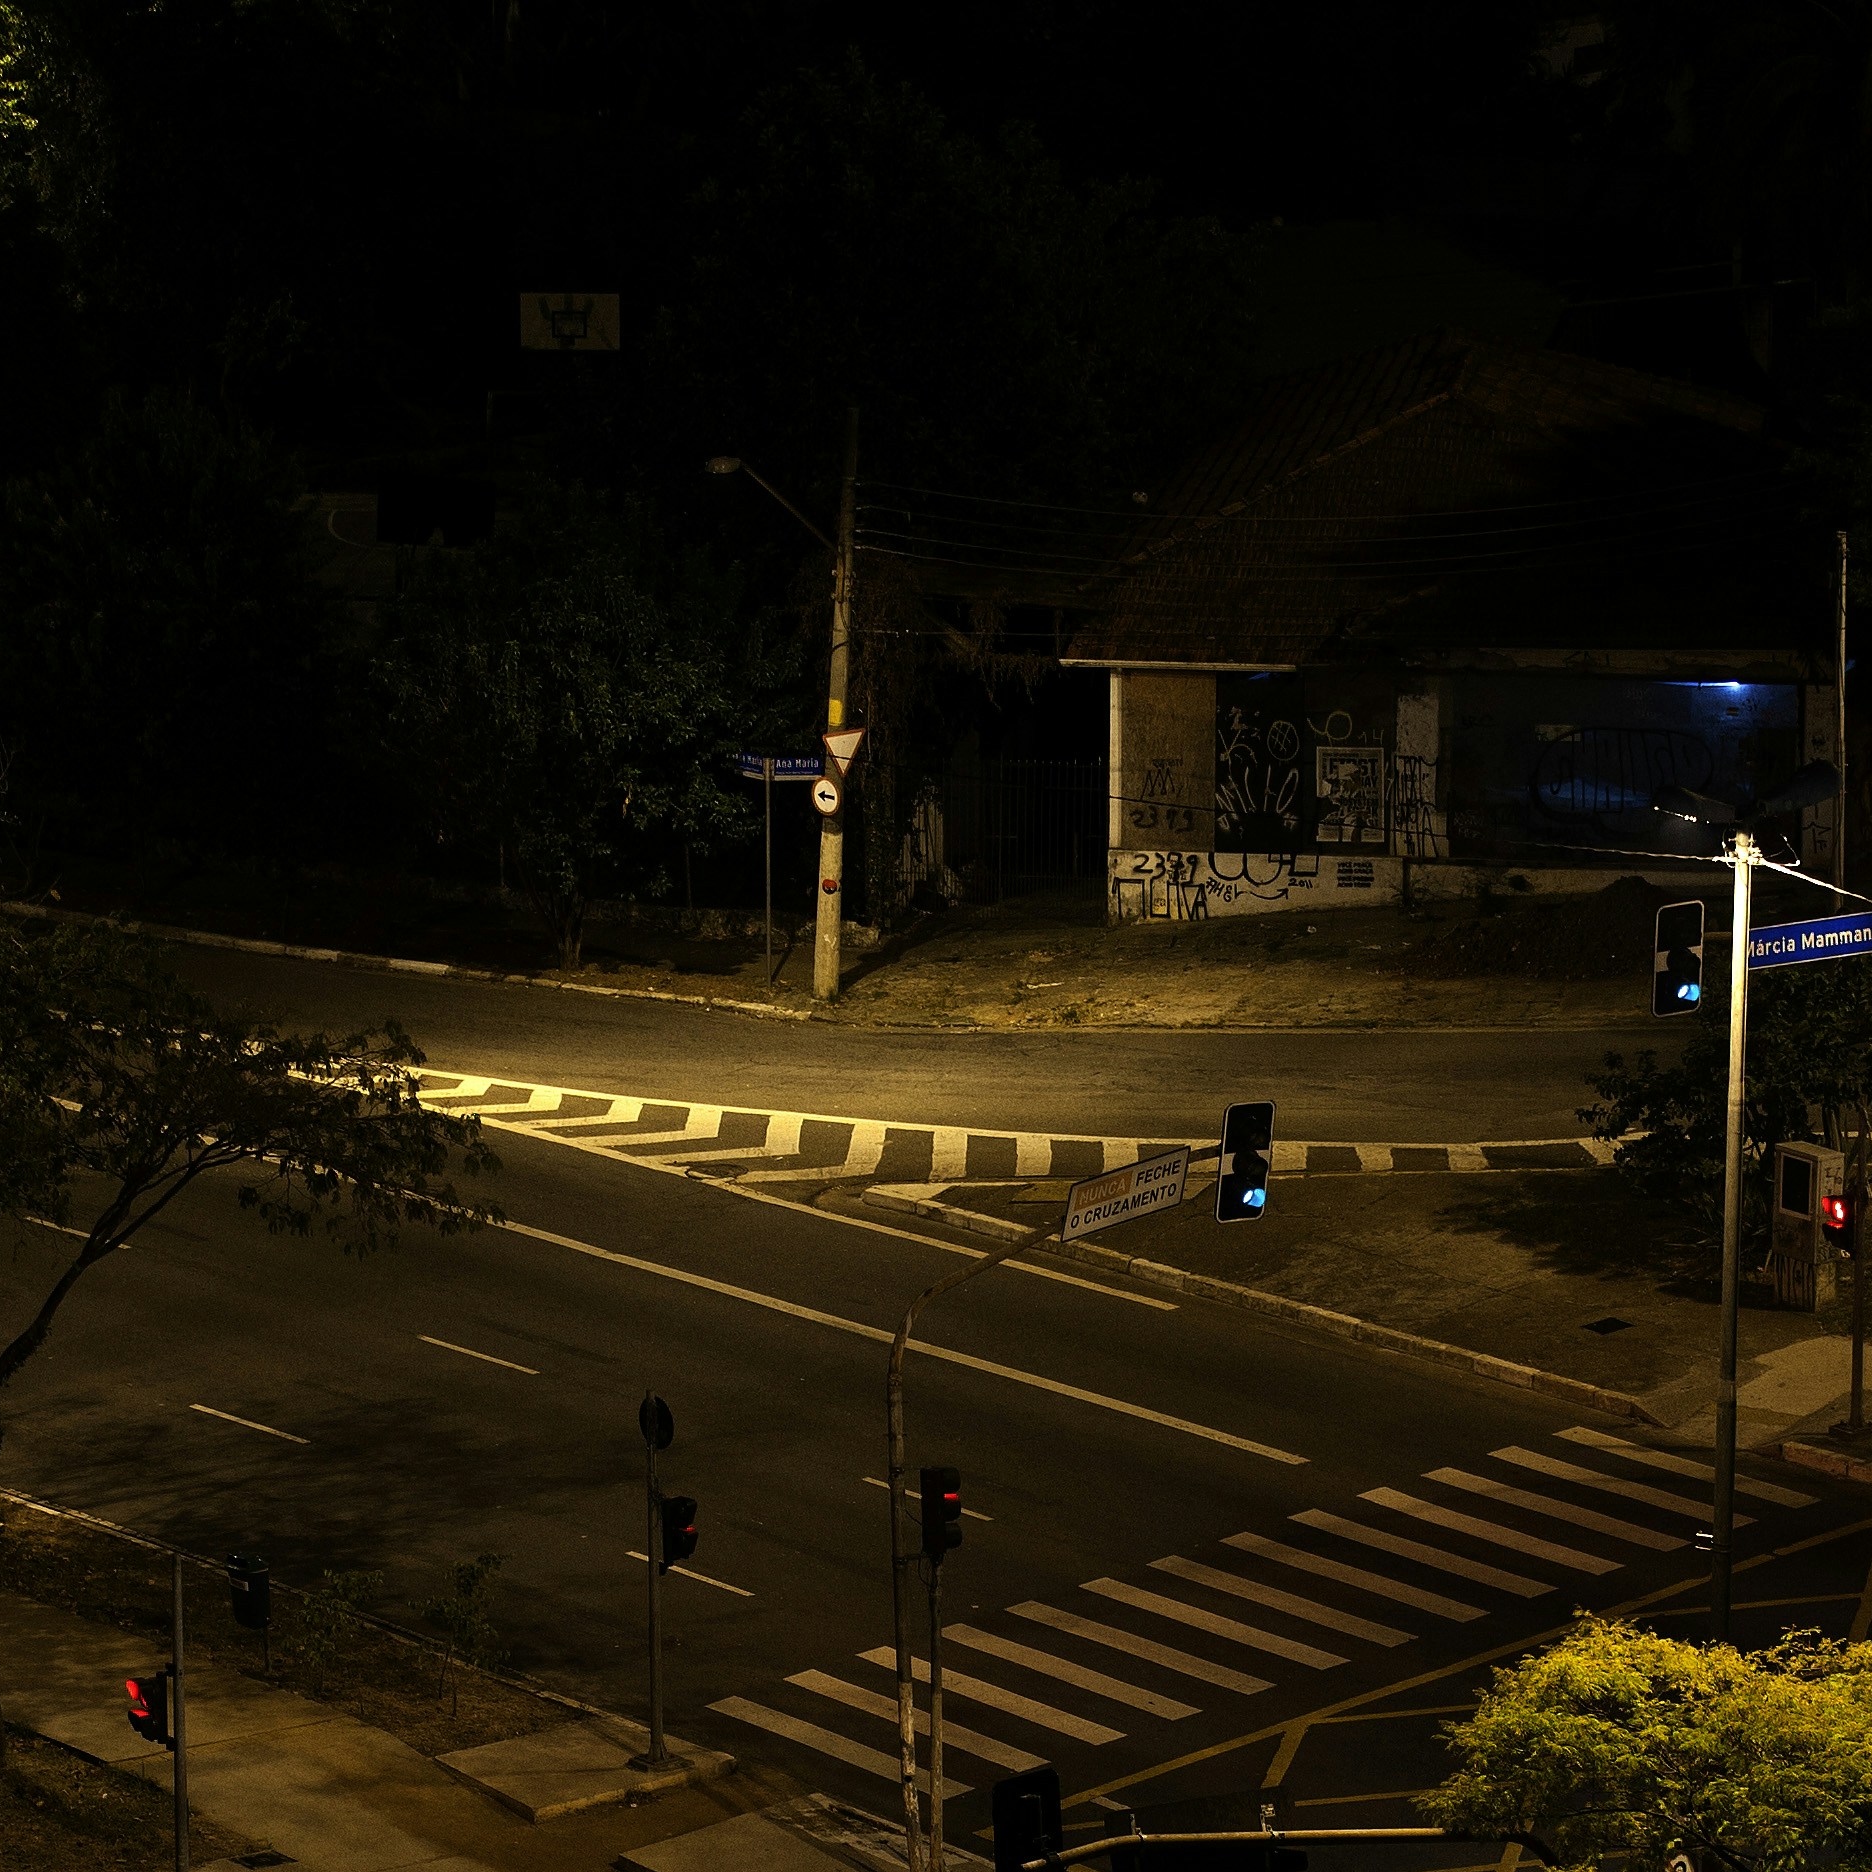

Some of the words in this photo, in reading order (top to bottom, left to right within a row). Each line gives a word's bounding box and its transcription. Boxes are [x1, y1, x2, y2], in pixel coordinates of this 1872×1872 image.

[775, 759, 793, 769] Ana
[795, 757, 820, 769] Maria
[1748, 936, 1796, 957] Márcia
[1078, 1179, 1126, 1205] NUNCA
[1136, 1160, 1182, 1187] FECHE
[1070, 1214, 1080, 1229] O
[1084, 1183, 1177, 1225] CRUZAMENTO
